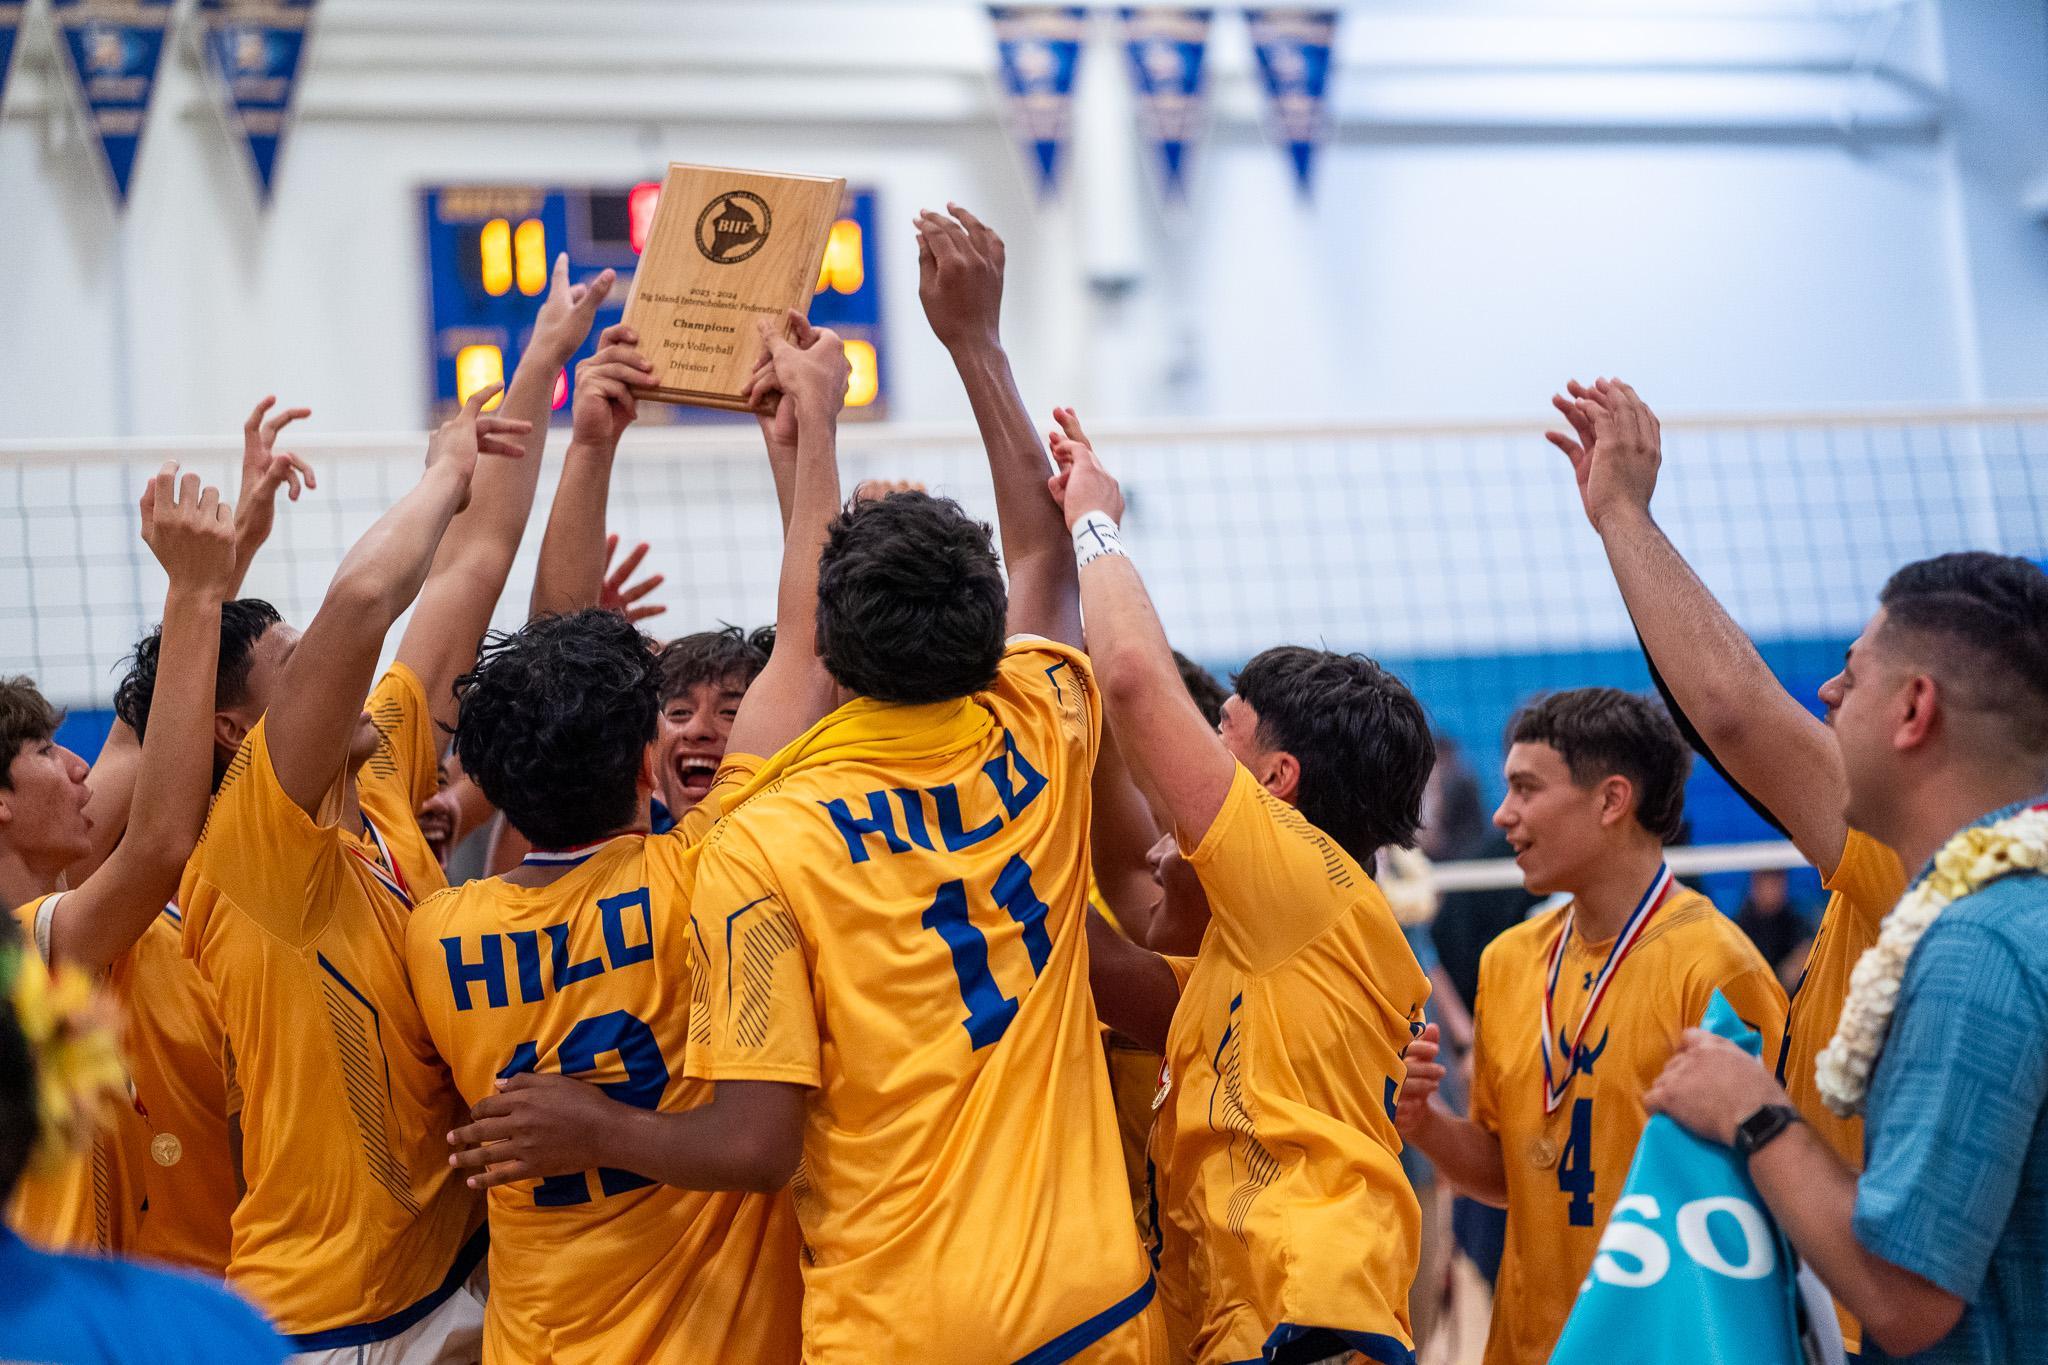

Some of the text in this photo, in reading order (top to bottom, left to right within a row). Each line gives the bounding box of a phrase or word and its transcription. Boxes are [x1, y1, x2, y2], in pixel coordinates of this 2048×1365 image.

[718, 219, 753, 234] BIIF
[640, 292, 783, 315] Big Island Interscholastic Federation
[717, 290, 738, 300] 2024
[673, 318, 736, 333] Champions
[663, 339, 734, 356] Boys Volleyball
[669, 360, 709, 373] Division
[816, 727, 1049, 865] HILO
[439, 887, 655, 1012] HILO
[921, 852, 1053, 1053] 11
[1557, 1097, 1595, 1227] 4
